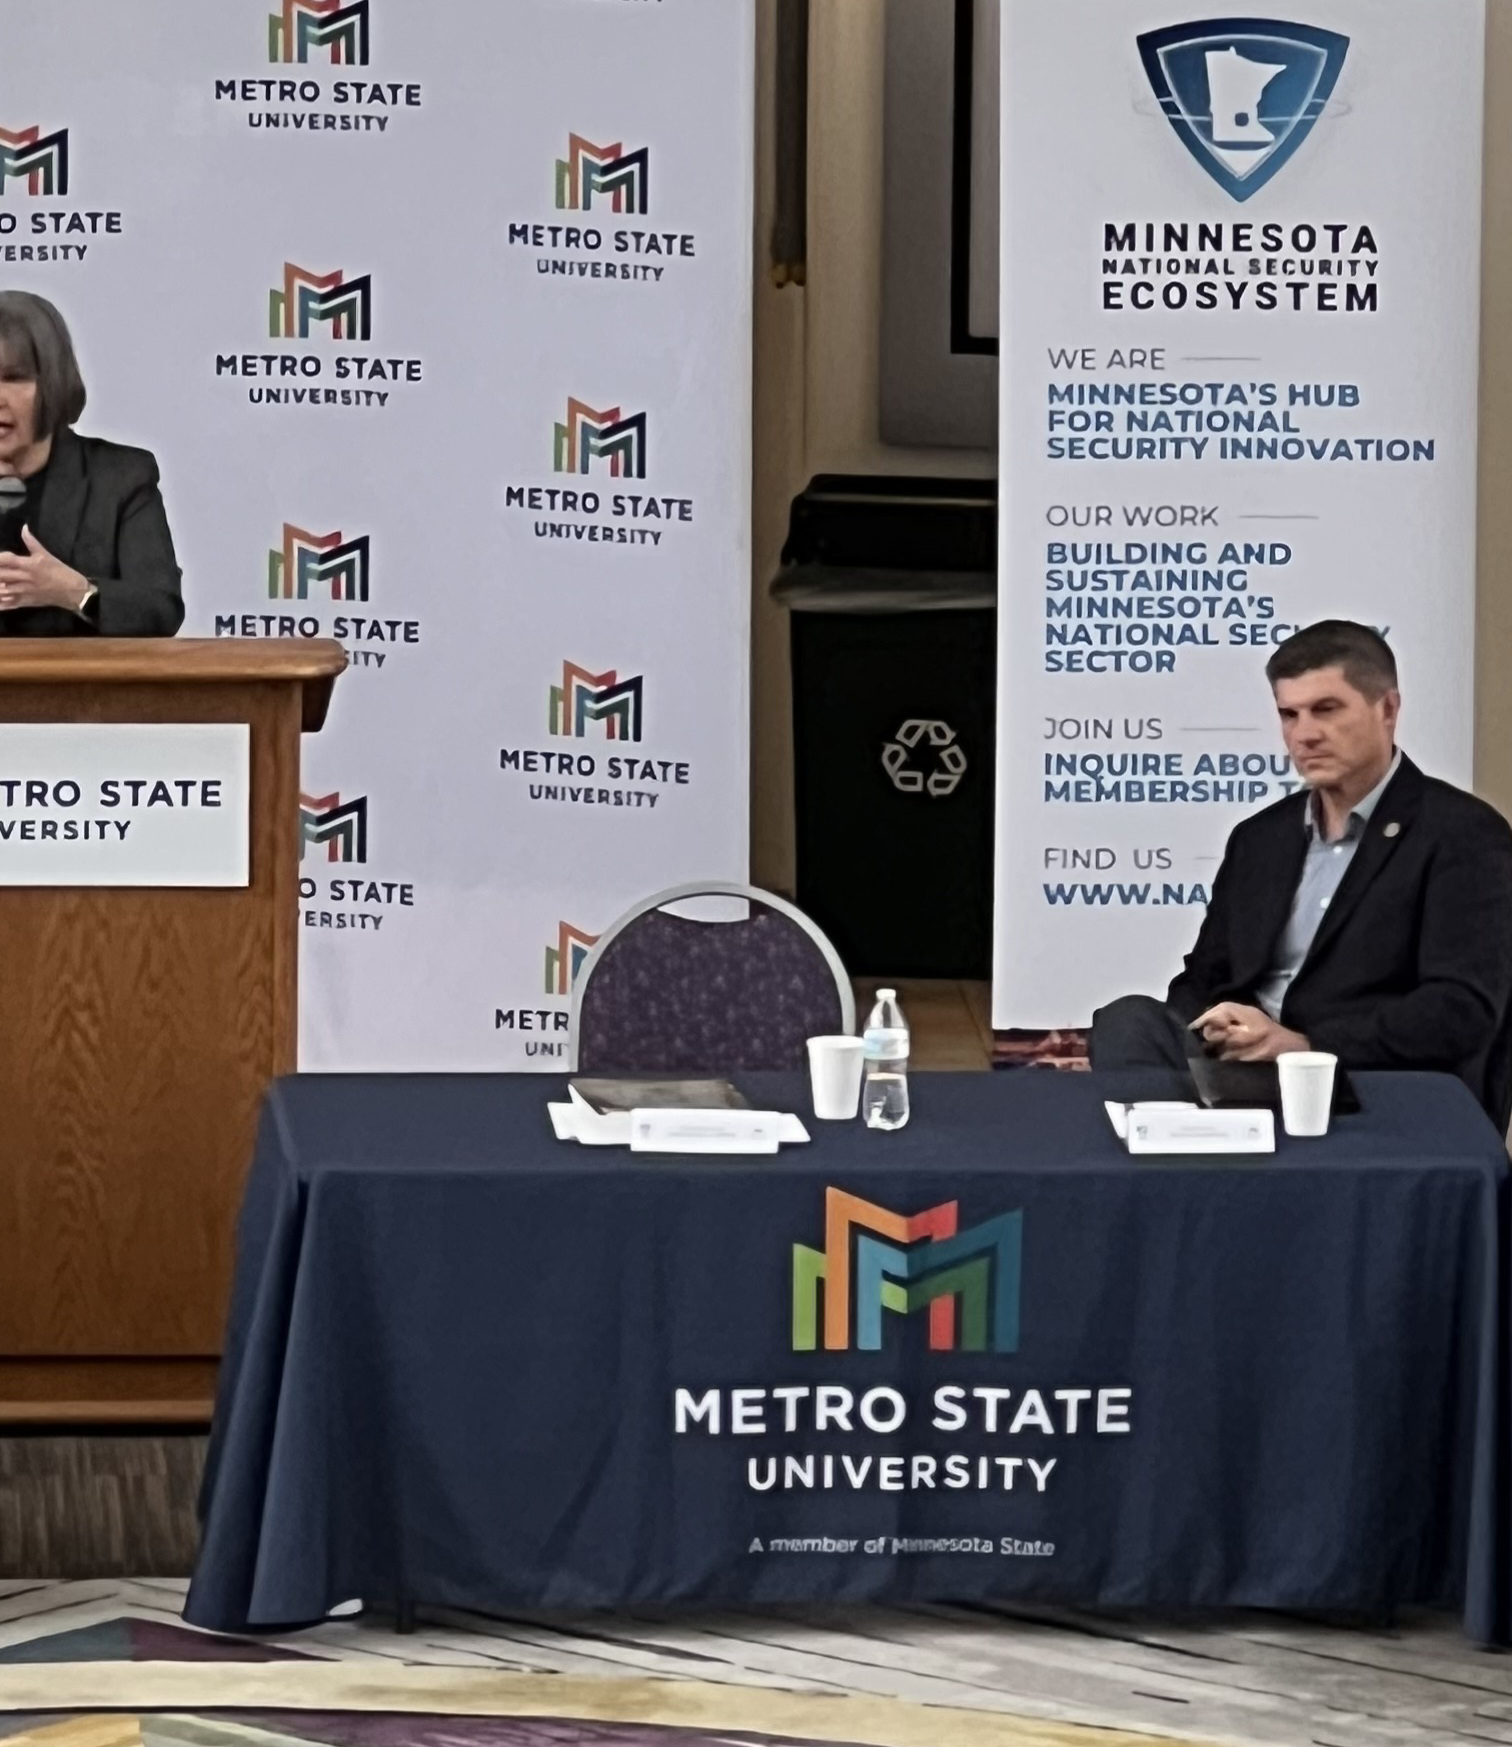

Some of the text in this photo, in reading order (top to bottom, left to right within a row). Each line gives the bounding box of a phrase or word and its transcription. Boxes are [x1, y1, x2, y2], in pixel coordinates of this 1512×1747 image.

[215, 79, 421, 107] METRO STATE
[248, 112, 389, 132] UNIVERSITY
[30, 211, 122, 234] STATE
[508, 223, 696, 257] METRO STATE
[1104, 222, 1378, 254] MINNESOTA
[536, 259, 665, 282] UNIVERSITY
[1102, 257, 1379, 277] NATIONAL SECURITY
[1103, 281, 1378, 312] ECOSYSTEM
[215, 354, 422, 382] METRO STATE
[1047, 347, 1166, 371] WE ARE
[248, 387, 389, 407] UNIVERSITY
[1048, 382, 1360, 408] MINNESOTA'S HUB
[1048, 409, 1301, 434] FOR NATIONAL
[1046, 436, 1435, 462] SECURITY INNOVATION
[505, 486, 693, 522] METRO STATE
[1045, 504, 1219, 527] OUR WORK
[534, 521, 662, 546] UNIVERSITY
[1047, 542, 1292, 566] BUILDING AND
[1045, 569, 1248, 592] SUSTAINING
[215, 615, 420, 644] METRO STATE
[1045, 622, 1220, 646] NATIONAL
[1044, 649, 1176, 673] SECTOR
[1044, 717, 1163, 740] JOIN US
[499, 748, 690, 785] METRO STATE
[1044, 753, 1289, 779] INQUIRE ABOU
[99, 780, 222, 808] STATE
[529, 784, 659, 808] UNIVERSITY
[1044, 780, 1269, 803] MEMBERSHIP
[1044, 847, 1173, 871] FIND US
[329, 879, 414, 907] STATE
[305, 911, 383, 930] ERSITY
[495, 1009, 568, 1031] METR
[675, 1385, 1132, 1435] METRO STATE
[748, 1454, 1057, 1492] UNIVERSITY
[749, 1537, 764, 1553] A
[1000, 1537, 1055, 1556] State
